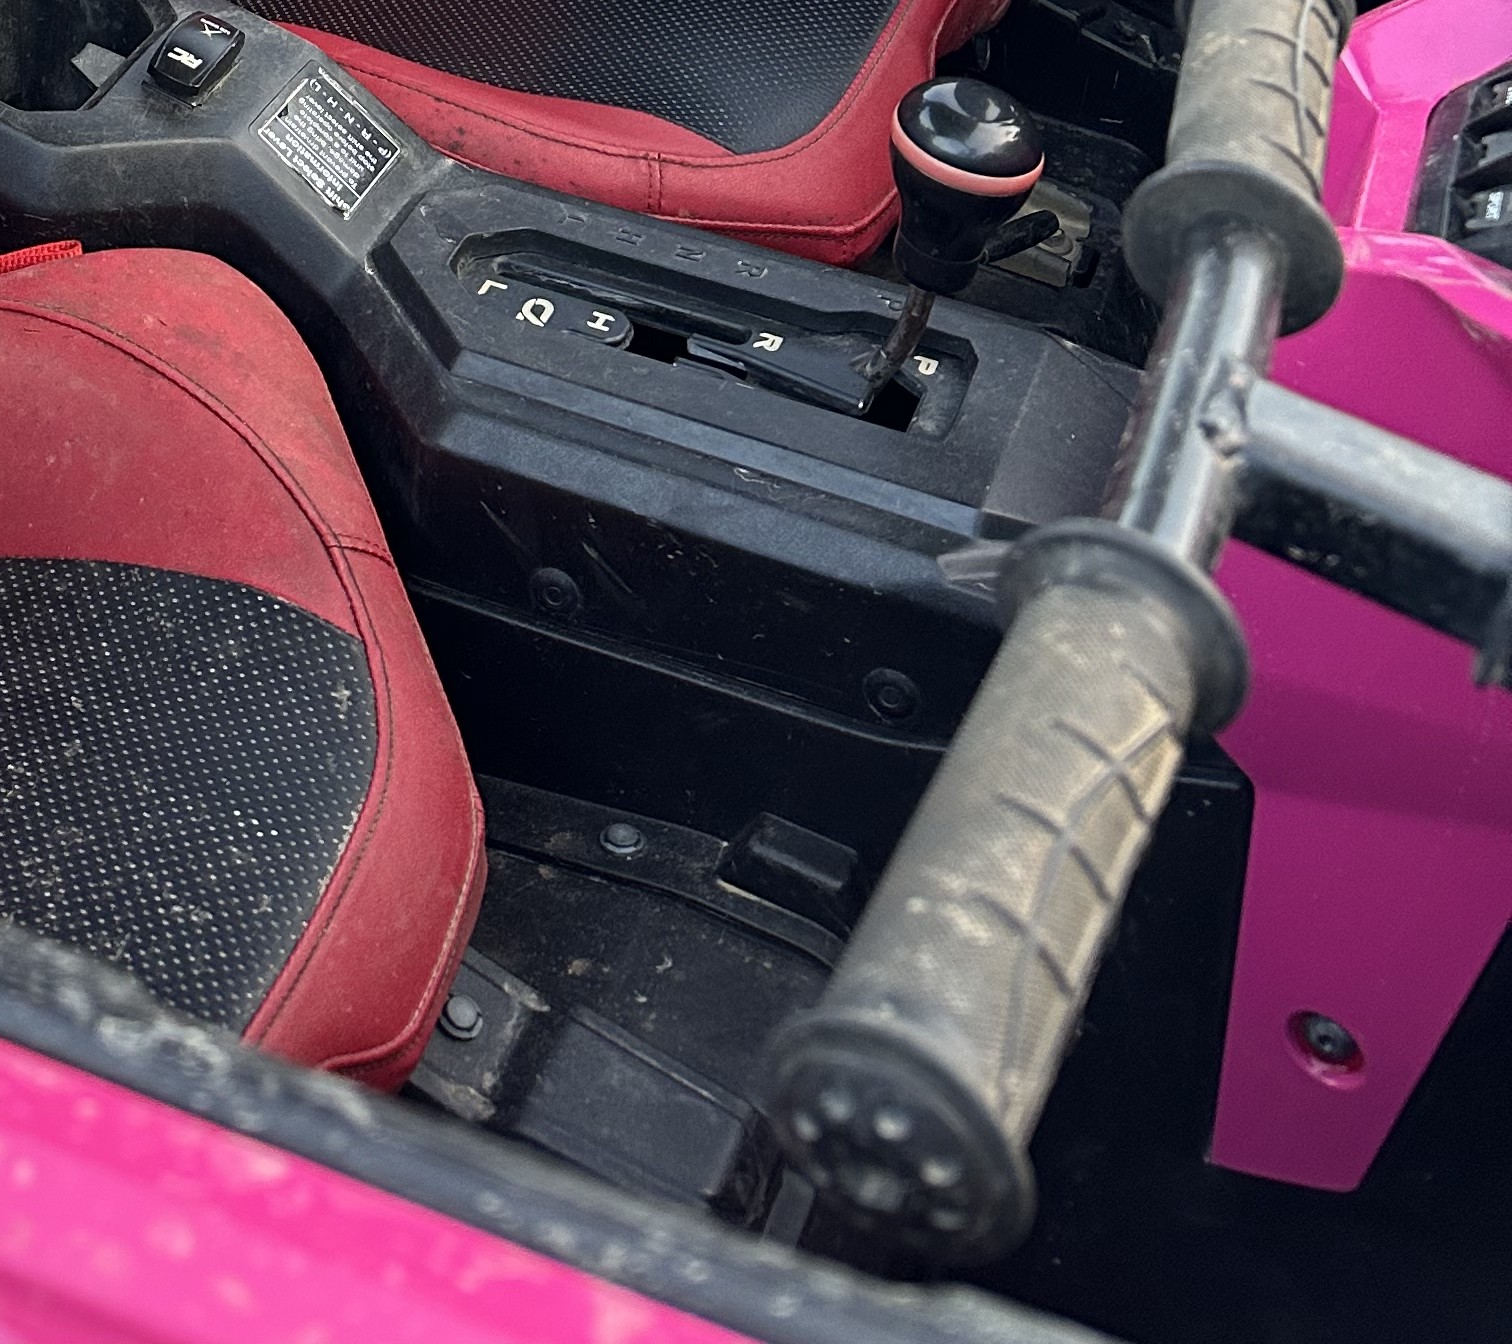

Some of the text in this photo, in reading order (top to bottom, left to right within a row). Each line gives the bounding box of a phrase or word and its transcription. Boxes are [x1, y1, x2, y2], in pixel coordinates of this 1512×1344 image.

[297, 96, 335, 133] operating
[326, 96, 339, 108] H
[292, 113, 308, 128] the
[305, 93, 378, 166] the shift select lever
[343, 112, 356, 124] N
[262, 126, 294, 157] Lever
[298, 108, 365, 173] unit to a complete
[306, 126, 328, 147] bring
[332, 130, 358, 156] before
[359, 127, 374, 141] R
[284, 132, 344, 192] Information
[291, 154, 326, 189] Select
[319, 149, 349, 179] prevent
[346, 177, 359, 190] To
[478, 279, 939, 375] P R H L
